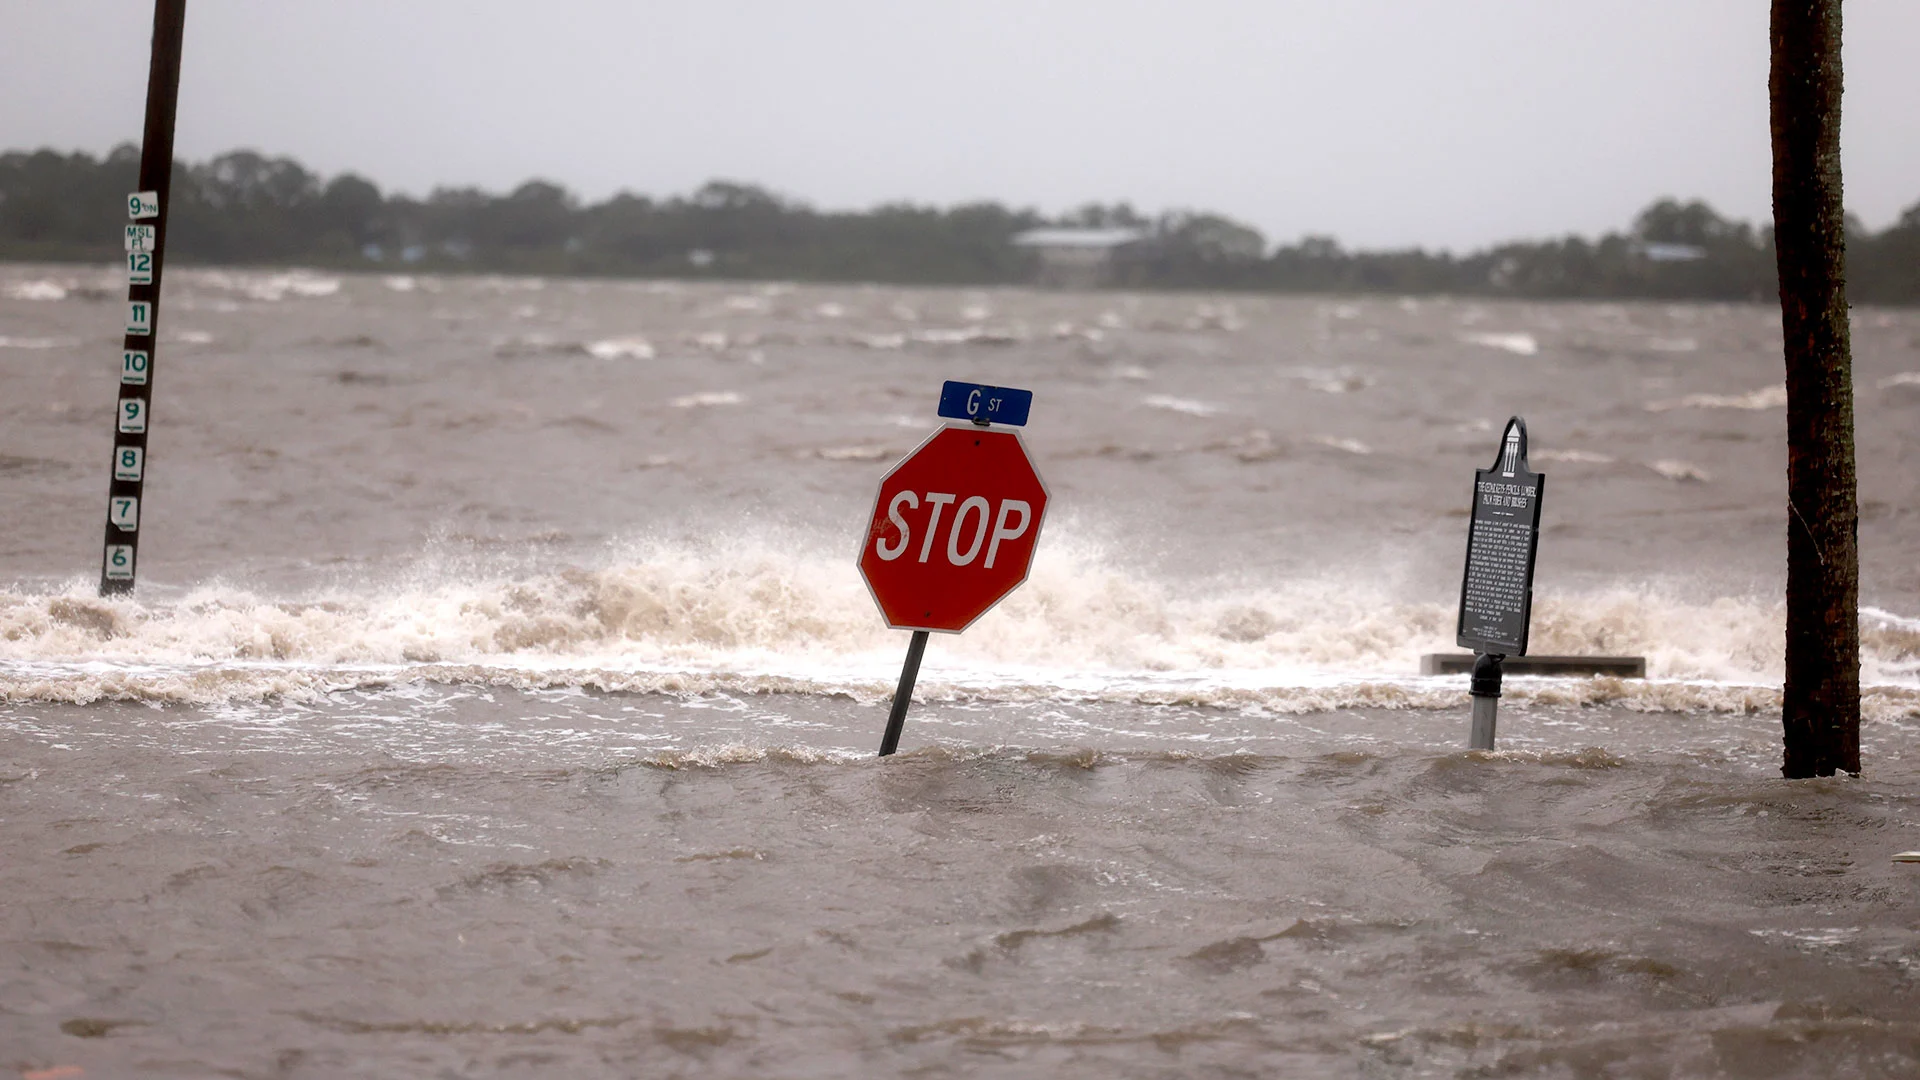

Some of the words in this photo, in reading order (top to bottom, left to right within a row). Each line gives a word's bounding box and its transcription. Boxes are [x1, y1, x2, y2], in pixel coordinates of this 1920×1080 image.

[127, 227, 153, 239] MSL
[129, 254, 150, 272] 12
[132, 304, 146, 322] 11
[124, 353, 147, 372] 10
[125, 402, 140, 420] 9
[966, 389, 982, 415] G
[987, 397, 1003, 412] ST
[121, 449, 137, 468] 8
[116, 500, 131, 518] 7
[876, 490, 1032, 569] STOP
[112, 547, 127, 567] 6
